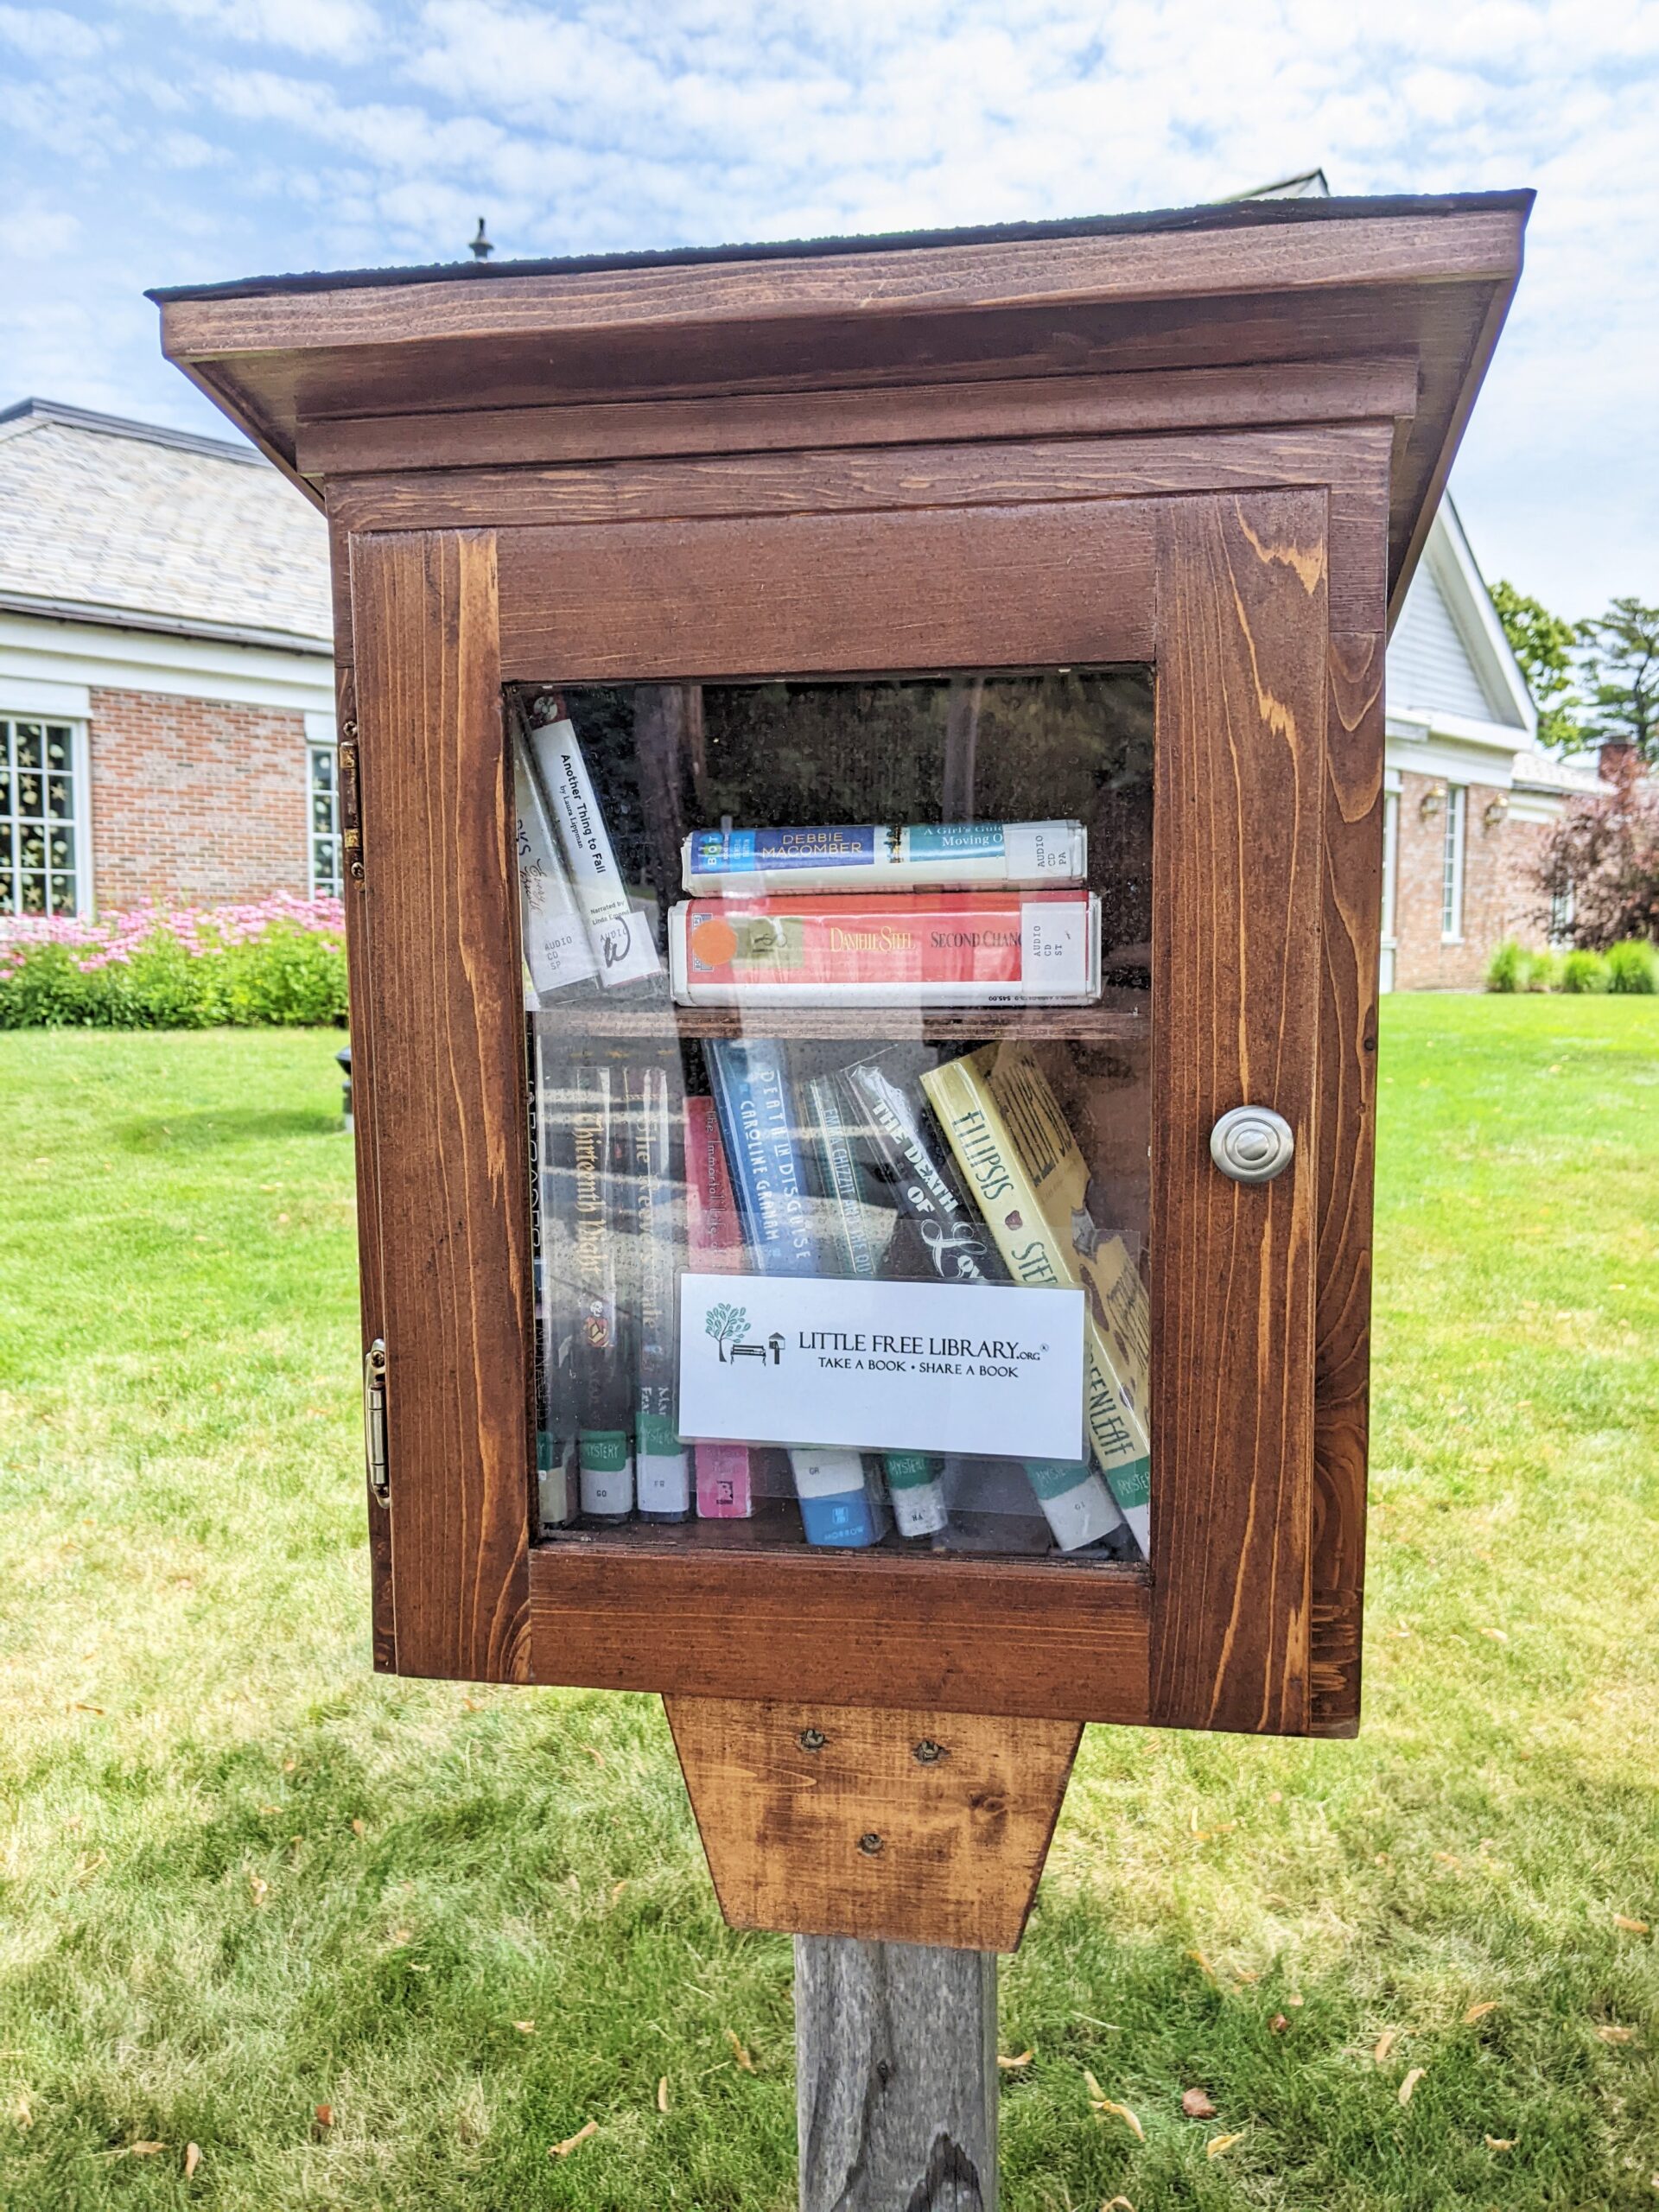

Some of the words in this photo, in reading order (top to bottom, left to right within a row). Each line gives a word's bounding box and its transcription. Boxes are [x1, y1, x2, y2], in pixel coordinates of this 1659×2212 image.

[561, 754, 582, 800] Another
[560, 785, 566, 794] by
[563, 795, 573, 816] Laura
[570, 817, 583, 849] Lippman
[576, 803, 592, 836] Thing
[783, 832, 843, 845] DEBBIE
[937, 826, 971, 835] Girl's
[942, 835, 989, 847] Moving
[993, 834, 1003, 842] O
[588, 837, 597, 851] to
[762, 842, 862, 858] MACOMBER
[1036, 835, 1046, 868] AUDIO
[592, 853, 607, 874] Fall
[1048, 853, 1056, 867] CD
[1058, 852, 1066, 865] PA
[590, 902, 616, 915] Narrated
[592, 917, 608, 925] Linda
[544, 936, 573, 951] AUDIO
[1045, 944, 1052, 957] CD
[1055, 944, 1062, 956] ST
[547, 951, 558, 961] CD
[550, 961, 562, 970] SP
[760, 1070, 787, 1135] DEATH
[825, 1108, 843, 1146] EMMA
[773, 1143, 791, 1157] IN
[873, 1098, 906, 1145] THE
[905, 1146, 959, 1213] DEATH
[953, 1110, 1014, 1200] ELLIPSIS
[572, 1113, 607, 1212] Thirteenth
[707, 1140, 725, 1199] Immortal
[741, 1100, 768, 1175] CAROLINE
[756, 1179, 779, 1241] GRAHAM
[832, 1149, 855, 1193] CHIZZIT
[907, 1185, 935, 1213] OF
[779, 1165, 810, 1259] DISGUISE
[577, 1218, 608, 1274] Night
[855, 1254, 873, 1274] QU
[799, 1332, 867, 1351] LITTLE
[872, 1334, 924, 1355] FREE
[818, 1357, 851, 1369] TAKE
[855, 1359, 864, 1370] A
[868, 1359, 906, 1372] BOOK
[919, 1362, 963, 1375] SHARE
[966, 1365, 975, 1376] A
[979, 1365, 1019, 1378] BOOK
